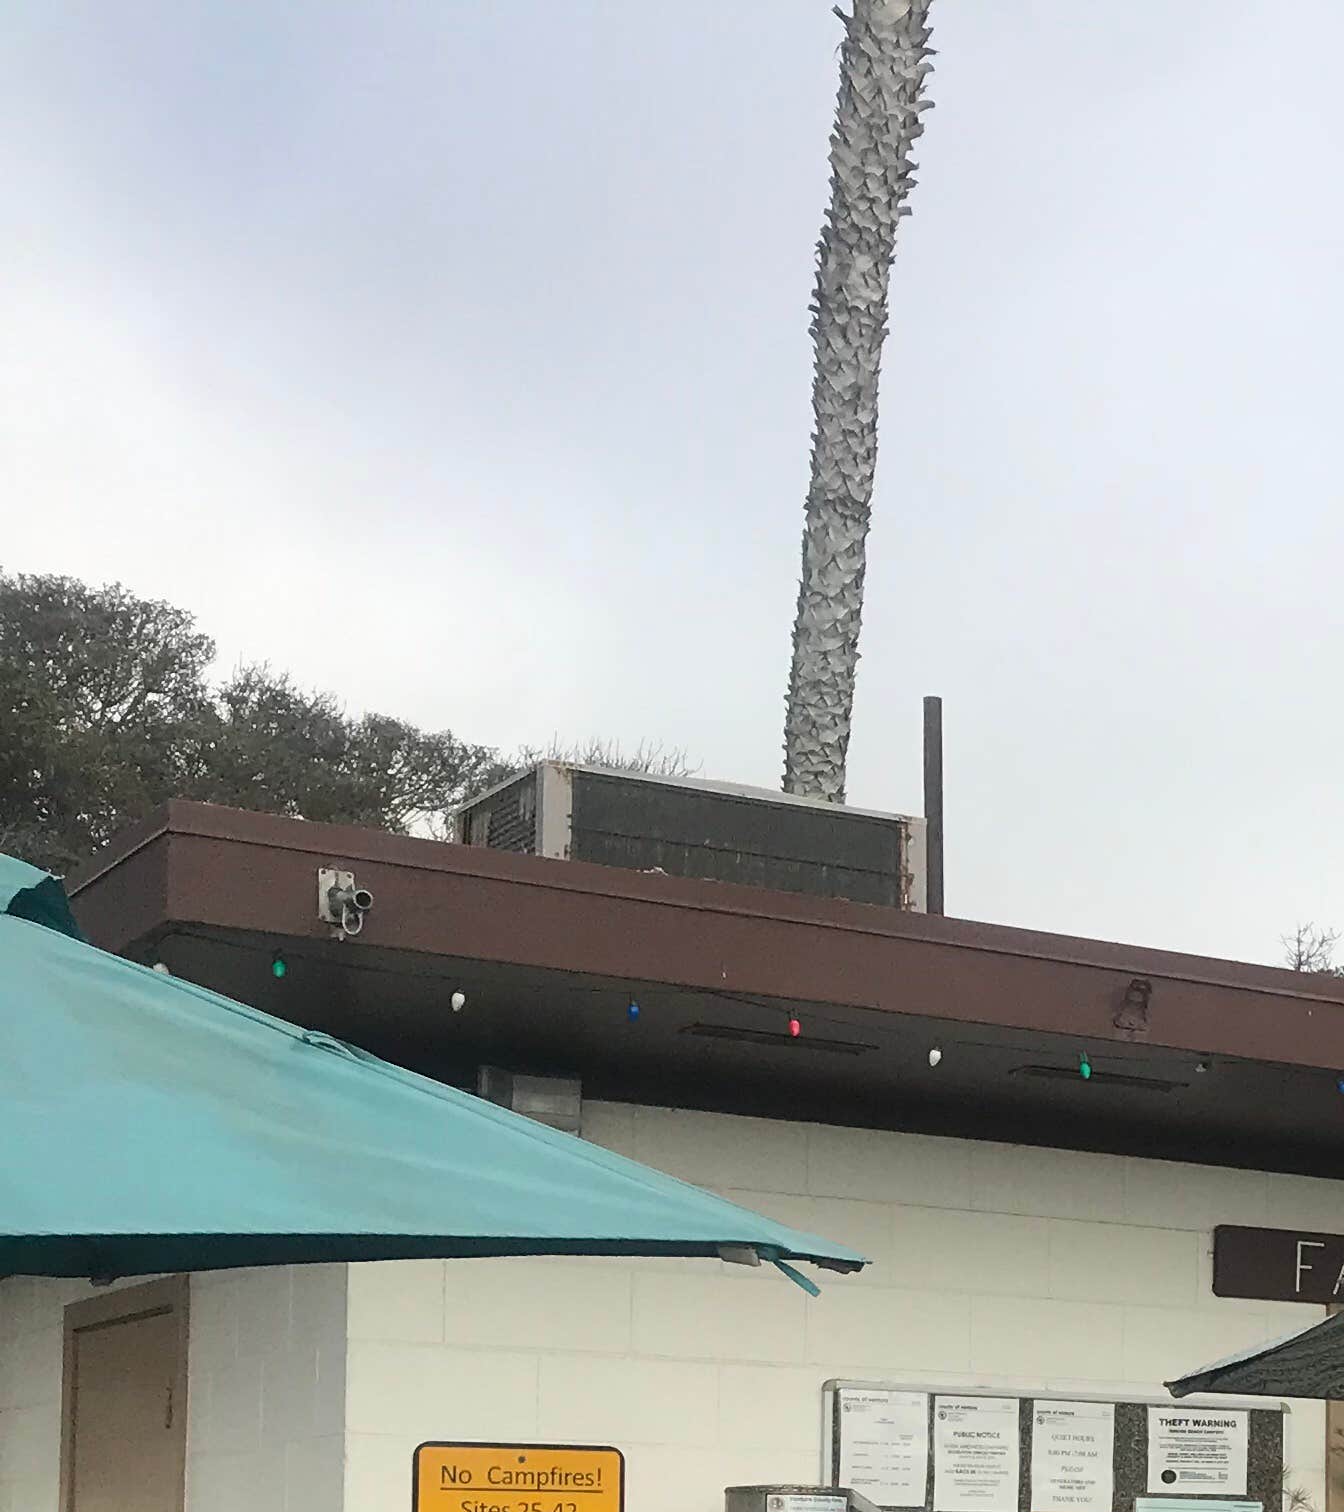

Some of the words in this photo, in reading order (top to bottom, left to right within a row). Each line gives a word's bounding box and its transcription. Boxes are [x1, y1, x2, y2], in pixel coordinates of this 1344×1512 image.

[1159, 1418, 1190, 1427] THEFT
[1192, 1419, 1237, 1428] WARNING
[953, 1431, 975, 1439] PUBLIC
[976, 1431, 1001, 1440] NOTICE
[441, 1466, 472, 1484] No
[487, 1467, 602, 1489] Campfires!
